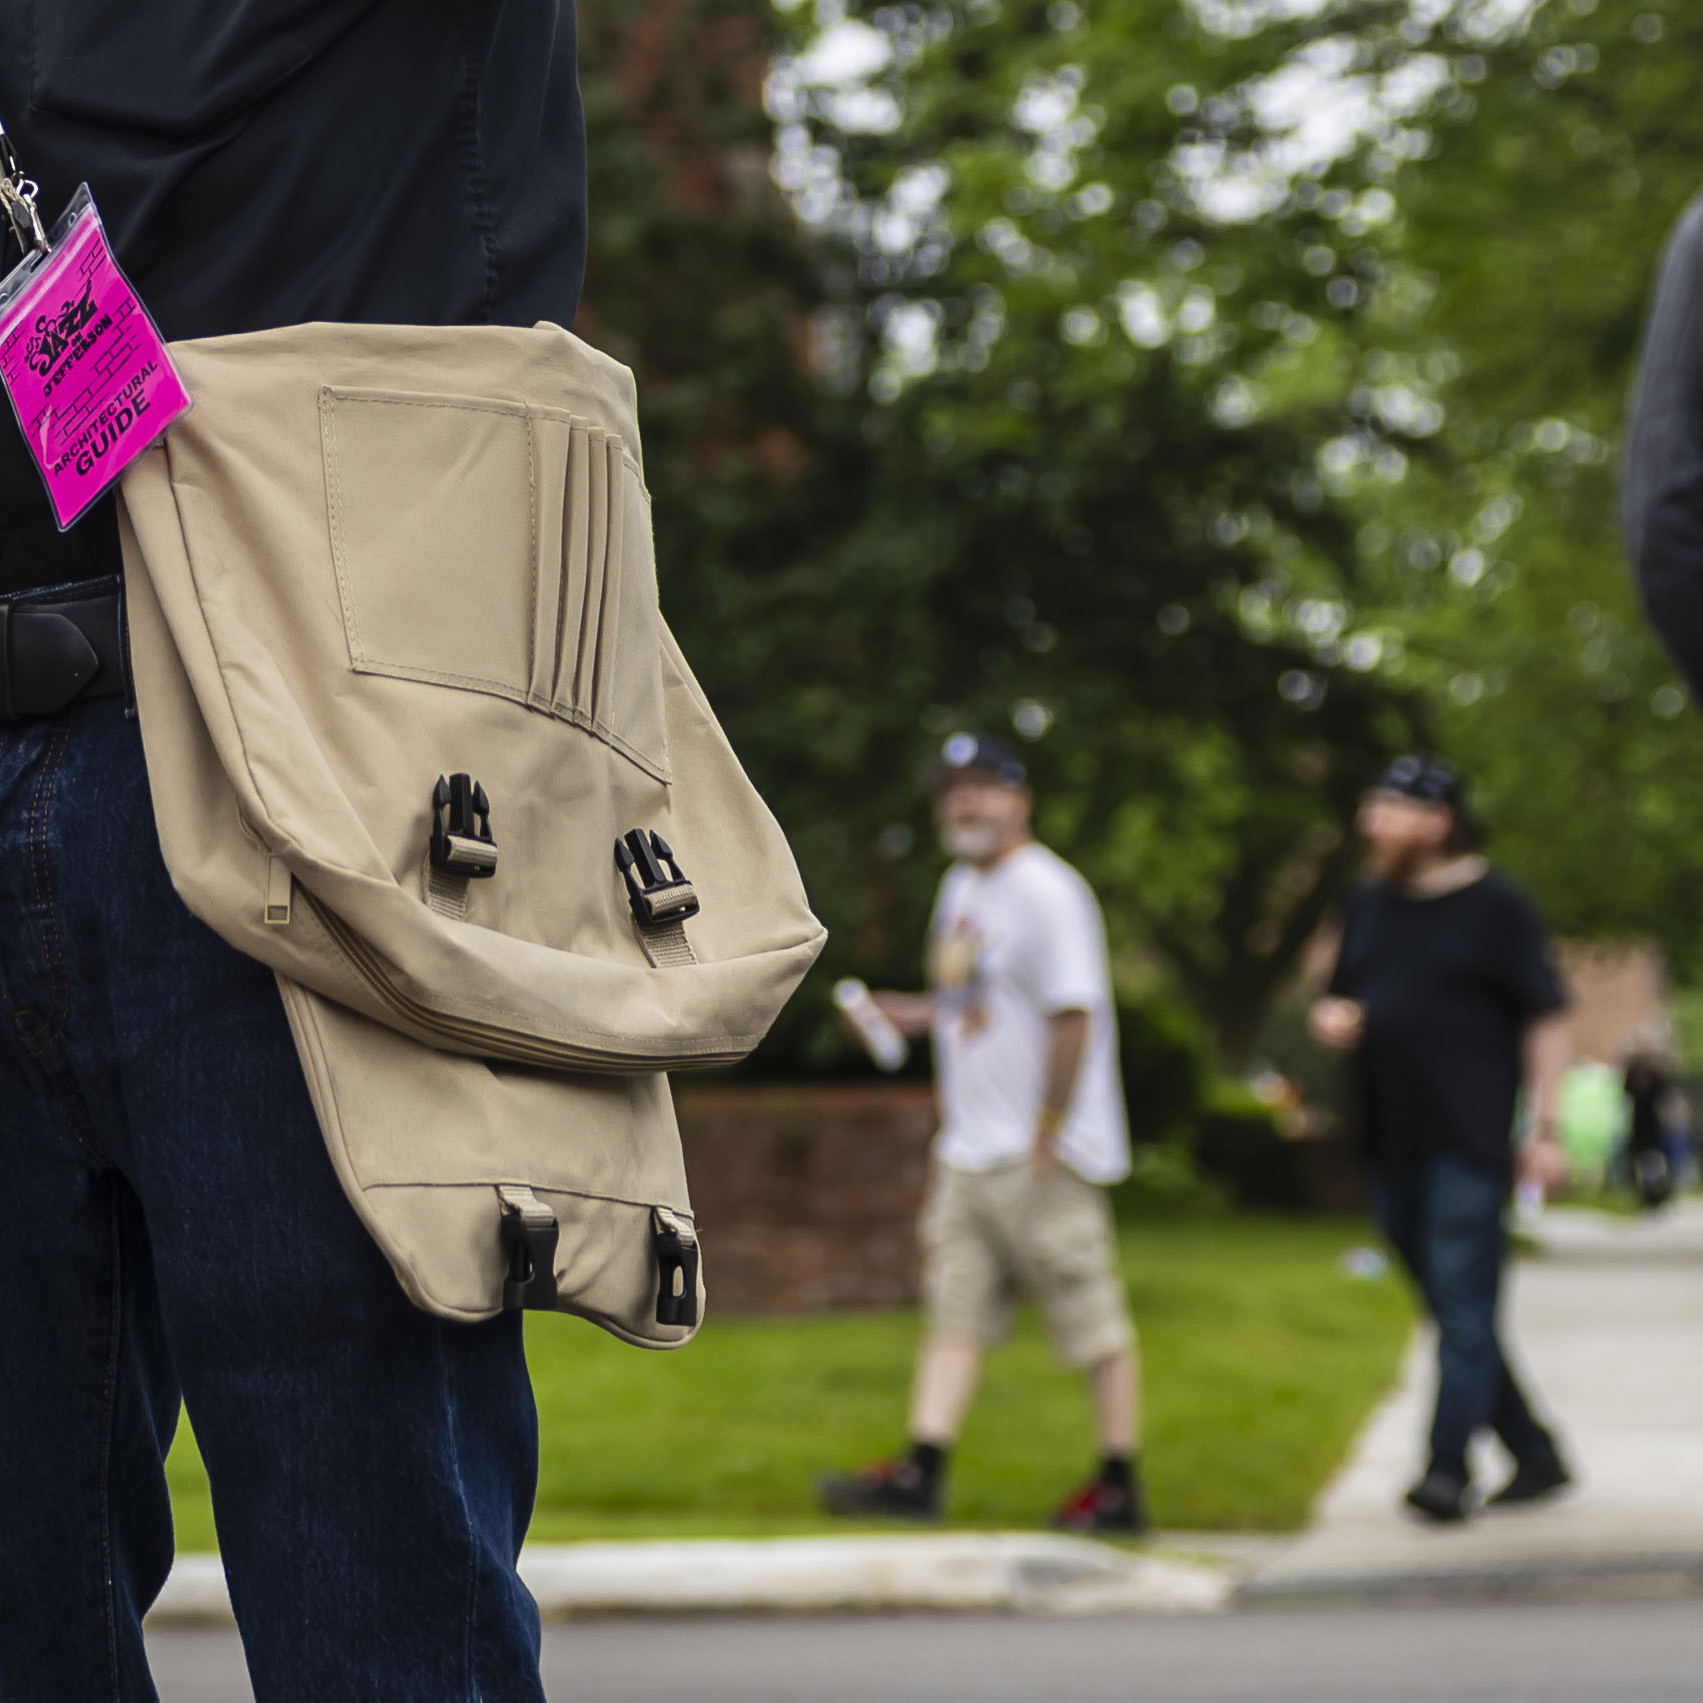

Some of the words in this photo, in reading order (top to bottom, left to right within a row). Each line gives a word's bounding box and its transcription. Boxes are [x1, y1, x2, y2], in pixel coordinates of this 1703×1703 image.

[31, 279, 98, 377] JAZZ
[43, 313, 113, 397] JEFFERSON
[54, 361, 159, 477] ARCHITECTURAL
[76, 389, 151, 476] GUIDE
